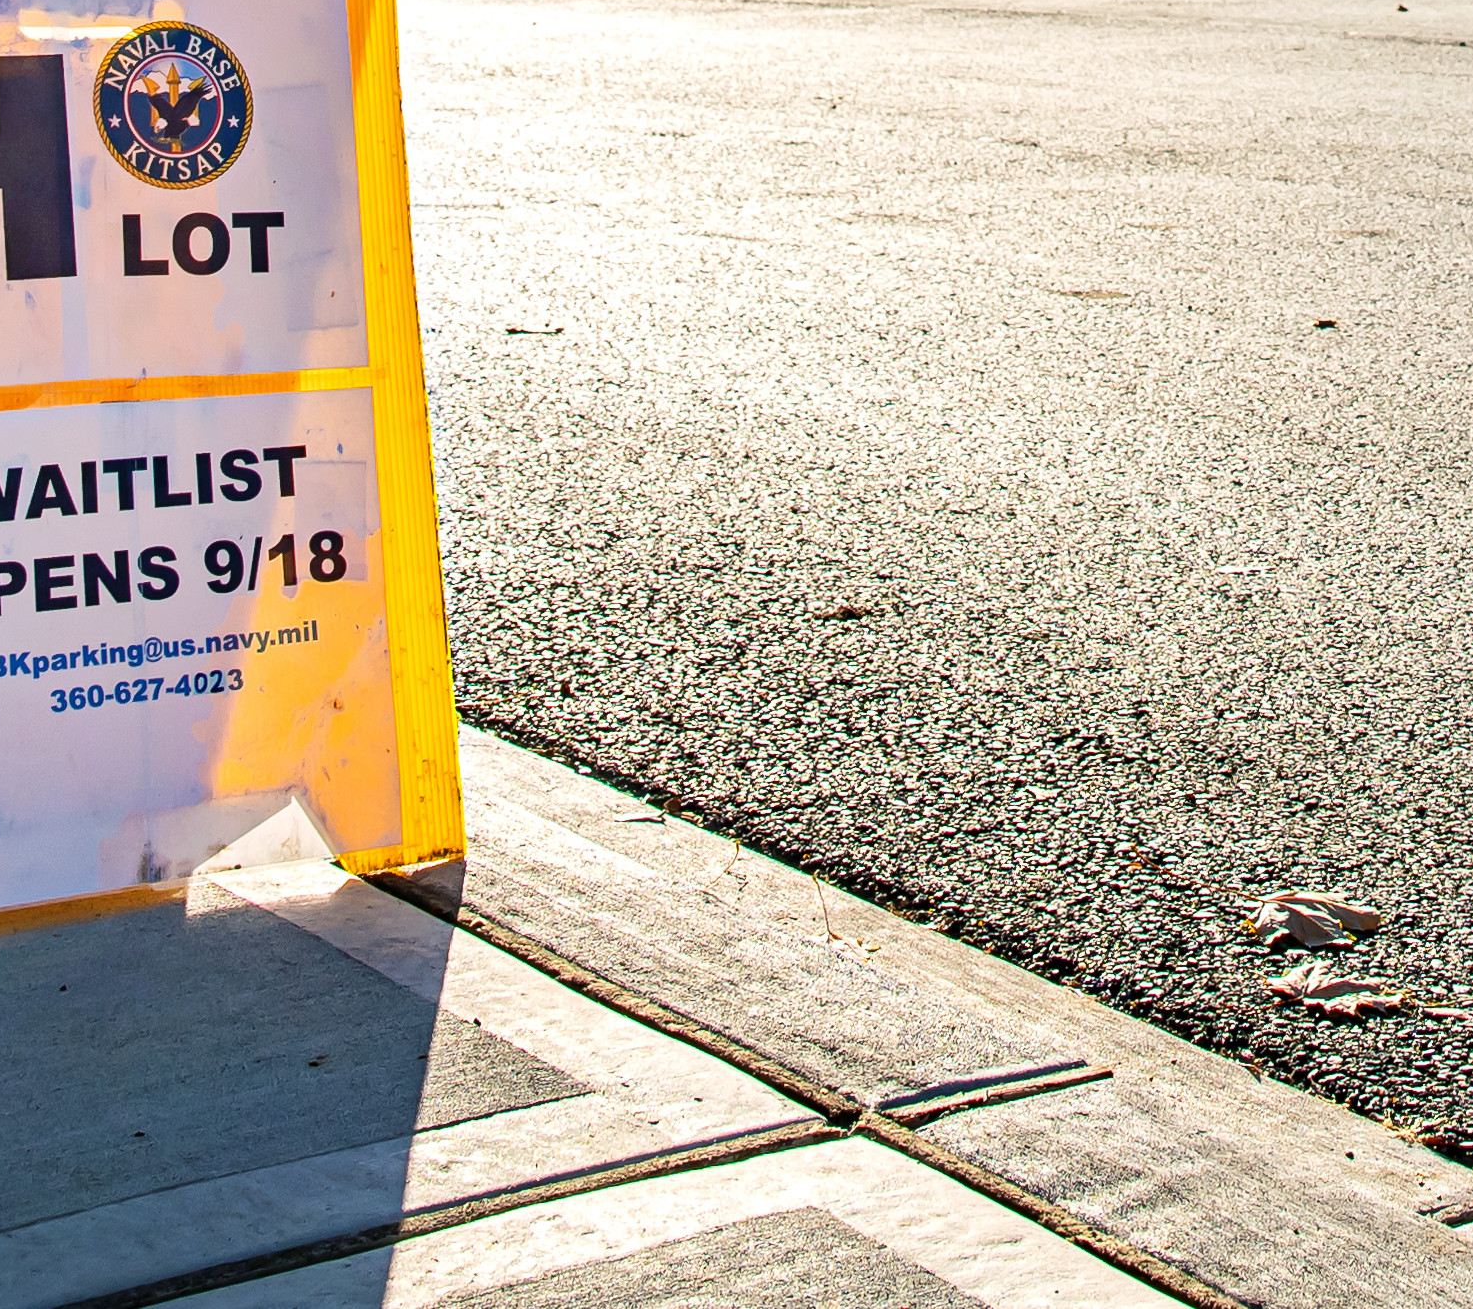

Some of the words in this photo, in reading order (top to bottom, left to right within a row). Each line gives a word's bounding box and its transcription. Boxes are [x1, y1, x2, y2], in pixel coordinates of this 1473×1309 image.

[103, 30, 177, 92] NAVAL
[185, 34, 241, 92] BASE
[122, 140, 226, 181] KITSAP
[122, 211, 285, 276] LOT
[203, 530, 348, 595] 9/18
[50, 668, 245, 713] 360-627-4023
